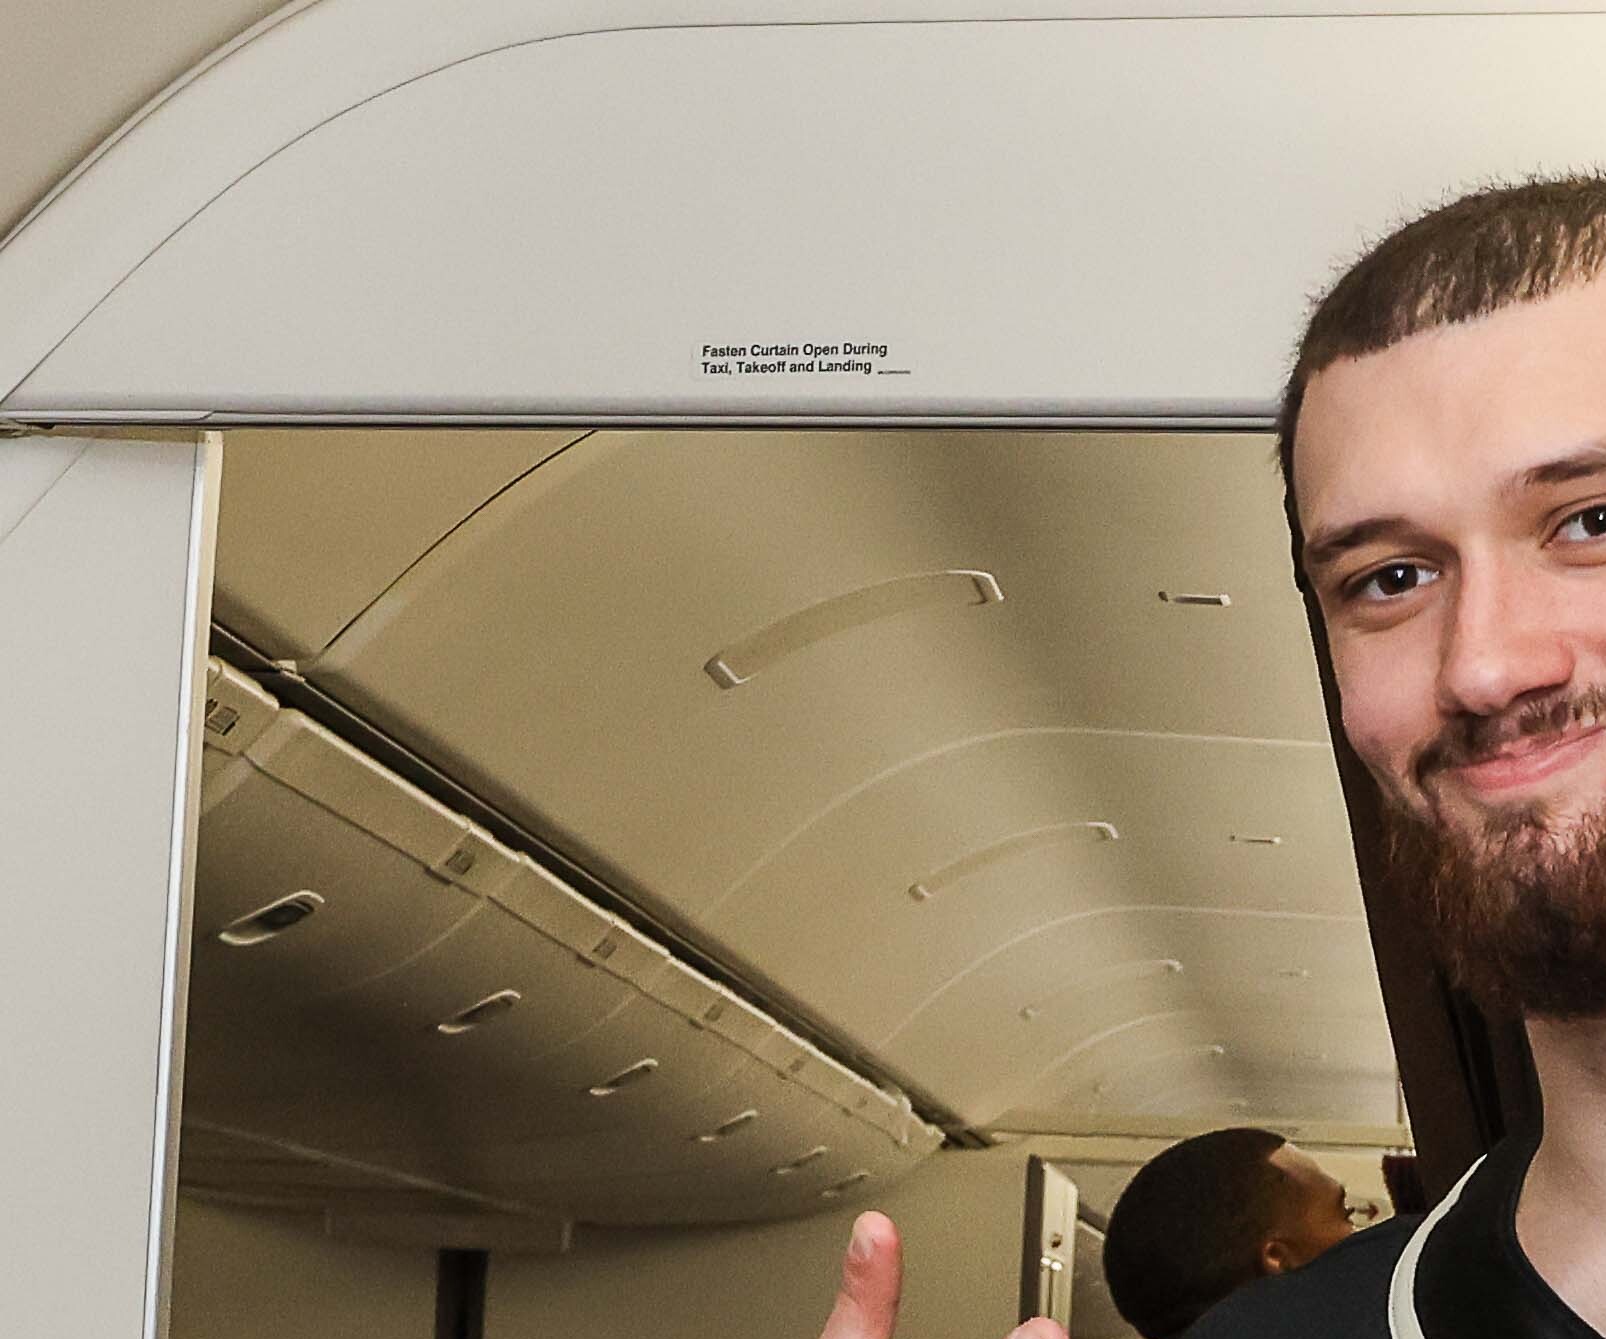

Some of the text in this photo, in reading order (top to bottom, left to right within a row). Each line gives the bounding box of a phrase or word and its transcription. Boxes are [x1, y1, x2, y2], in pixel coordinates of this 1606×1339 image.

[702, 343, 888, 358] Fasten Curtain Open During
[701, 360, 872, 375] Taxi, Takeoff and Landing
